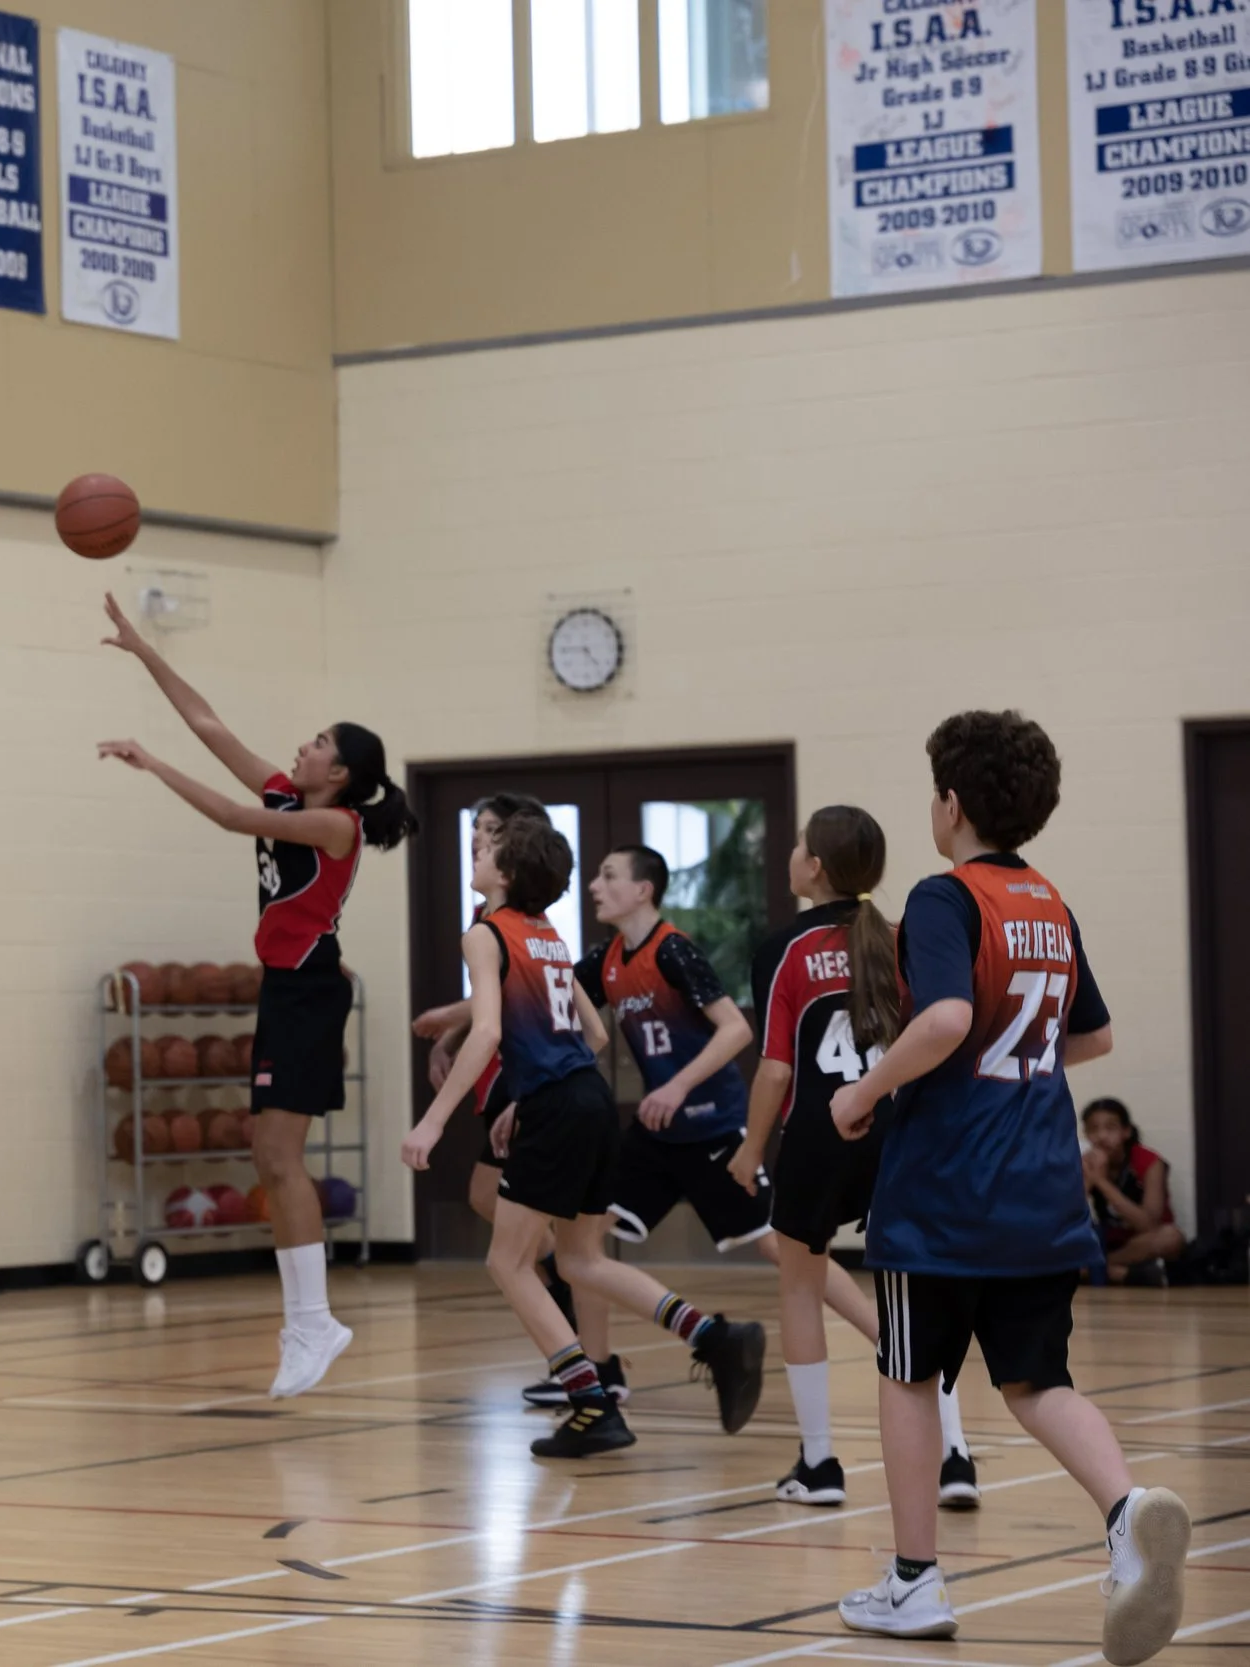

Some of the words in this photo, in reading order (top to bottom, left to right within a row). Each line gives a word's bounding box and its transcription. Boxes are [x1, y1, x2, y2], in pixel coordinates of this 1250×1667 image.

[871, 9, 992, 52] I.S.A.A.
[1122, 25, 1236, 59] Basketball
[855, 62, 879, 83] Jr
[886, 56, 933, 81] High
[941, 49, 1010, 72] Soccer
[1085, 70, 1106, 92] 1J
[1115, 63, 1176, 89] Grade
[78, 73, 156, 122] I.S.A.A.
[882, 84, 943, 107] Grade
[1129, 93, 1233, 130] LEAGUE
[923, 110, 944, 131] 1J
[885, 132, 984, 166] LEAGUE
[88, 181, 150, 216] LEAGUE
[861, 164, 1008, 204] CHAMPIONS
[72, 213, 165, 254] CHAMPIONS
[642, 1020, 672, 1056] 13
[976, 970, 1069, 1080] 23
